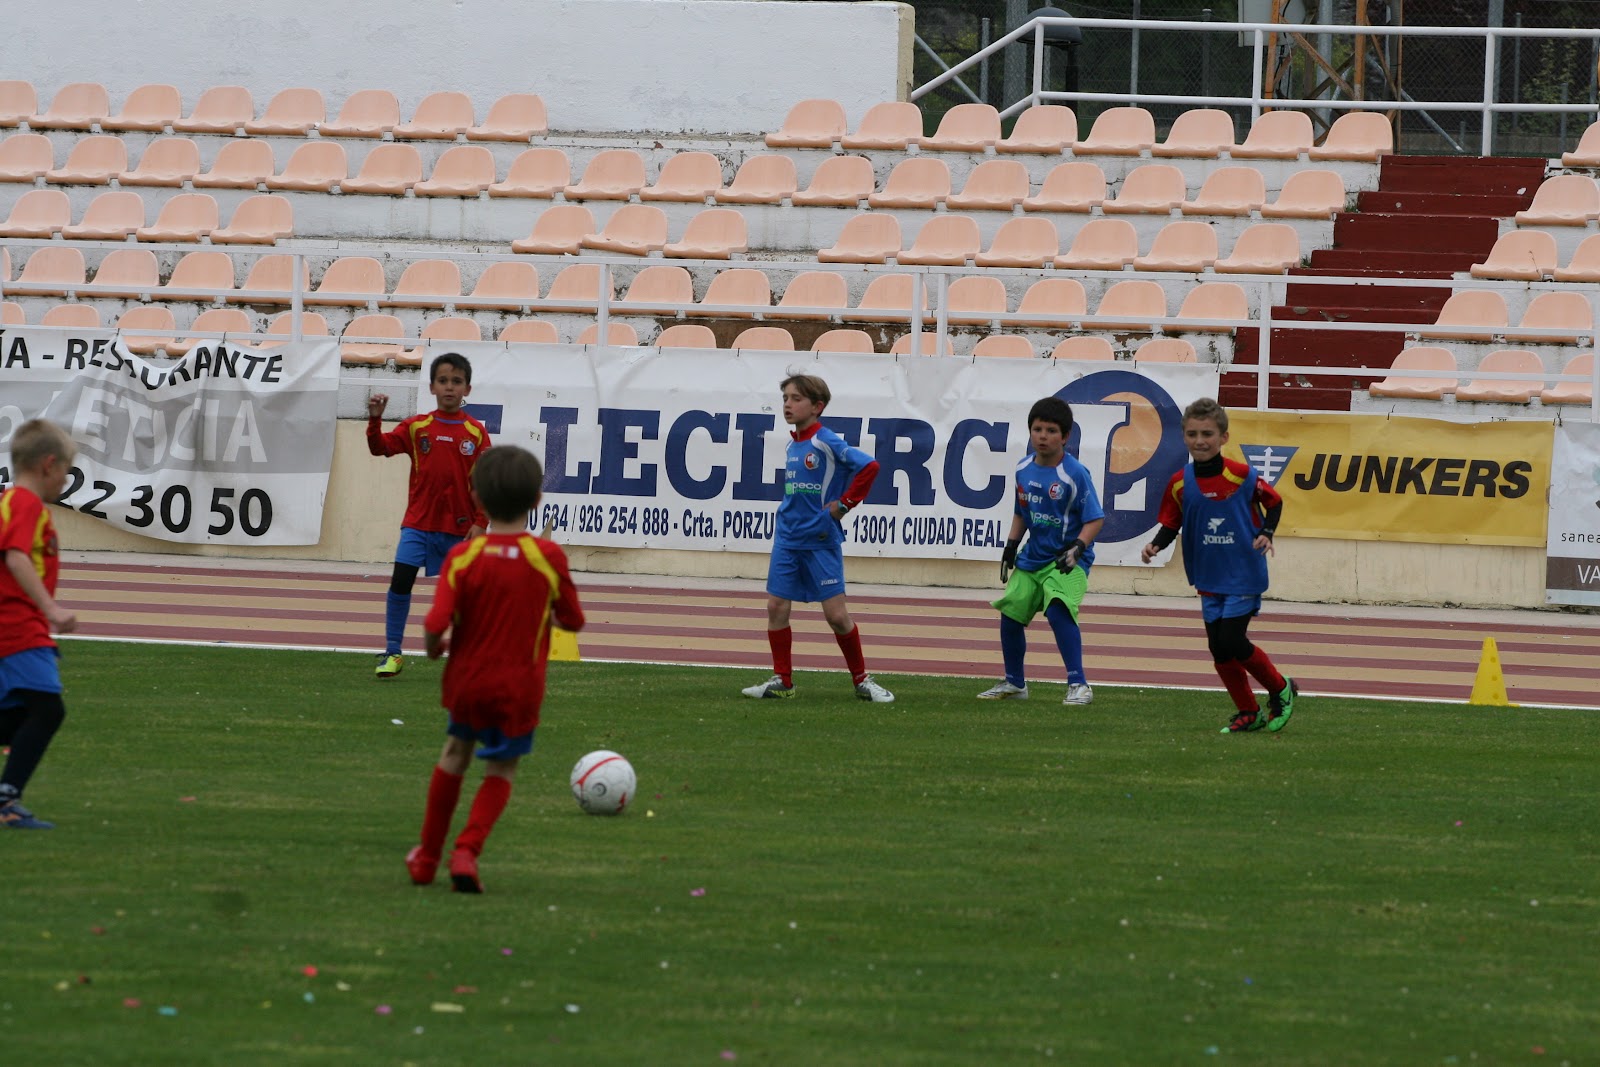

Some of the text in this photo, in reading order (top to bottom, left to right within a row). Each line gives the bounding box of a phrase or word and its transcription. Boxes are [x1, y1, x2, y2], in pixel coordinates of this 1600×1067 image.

[0, 329, 30, 369] A
[64, 338, 283, 390] RESURANTE
[38, 386, 268, 464] ETICIA
[1294, 453, 1532, 499] JUNKERS
[125, 485, 192, 534] 30
[207, 487, 273, 537] 50
[579, 504, 603, 533] 926
[608, 506, 638, 535] 254
[642, 507, 670, 537] 888
[682, 508, 718, 538] Crta.
[722, 510, 775, 540] PORZU
[852, 515, 896, 545] 13001
[902, 516, 957, 546] CIUDAD
[961, 518, 1005, 548] REAL
